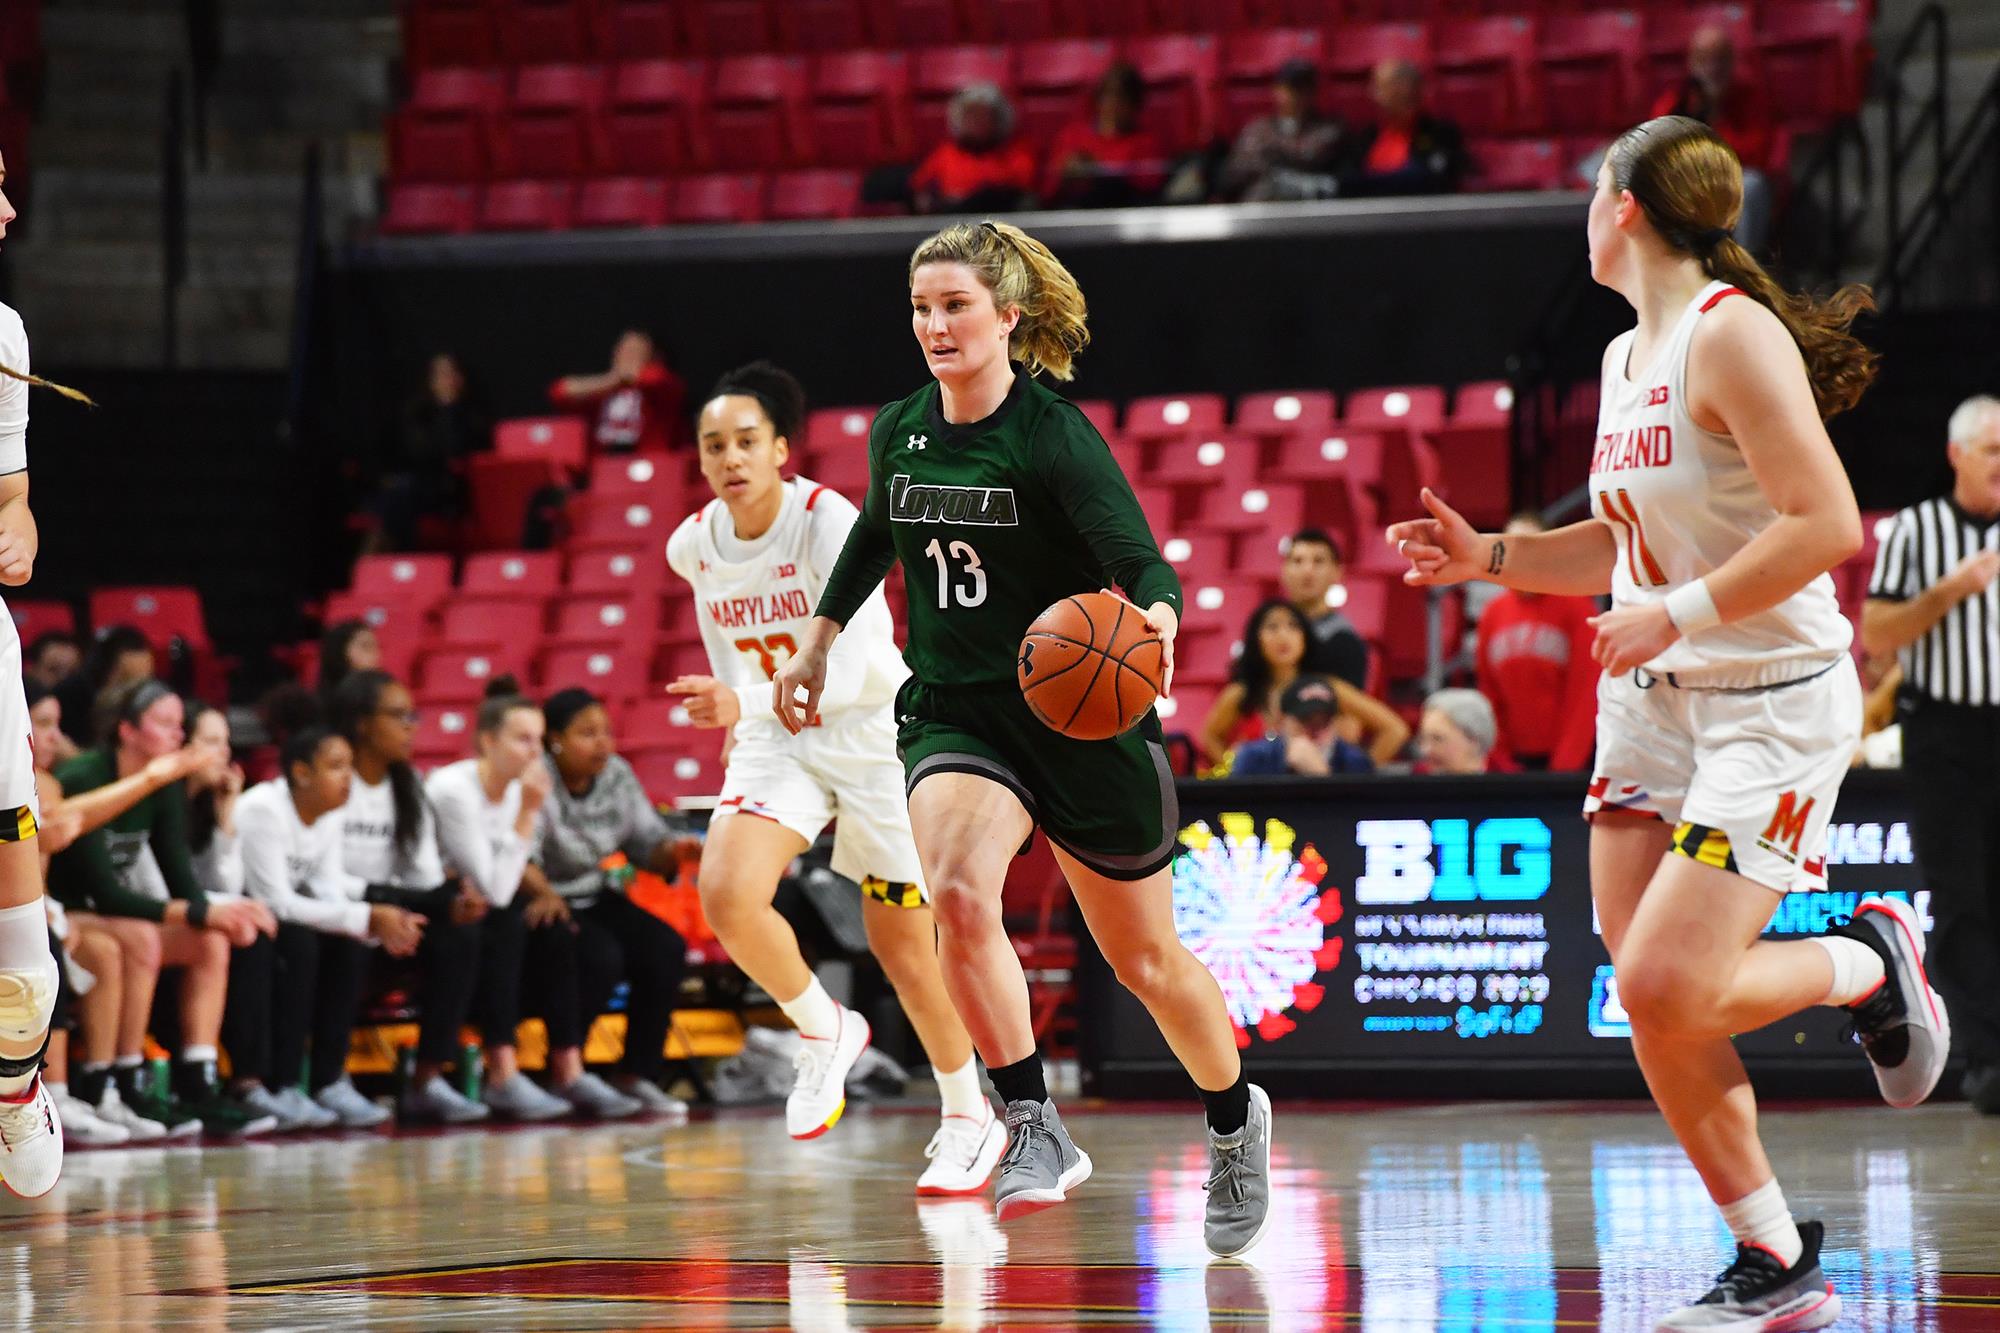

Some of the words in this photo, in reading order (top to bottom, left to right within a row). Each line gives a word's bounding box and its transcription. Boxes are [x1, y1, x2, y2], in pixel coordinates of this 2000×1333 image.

[1590, 425, 1673, 475] ARYLAND
[1599, 488, 1668, 586] 11
[924, 538, 988, 609] 13
[706, 589, 810, 629] MARYLAND
[1760, 789, 1817, 857] M
